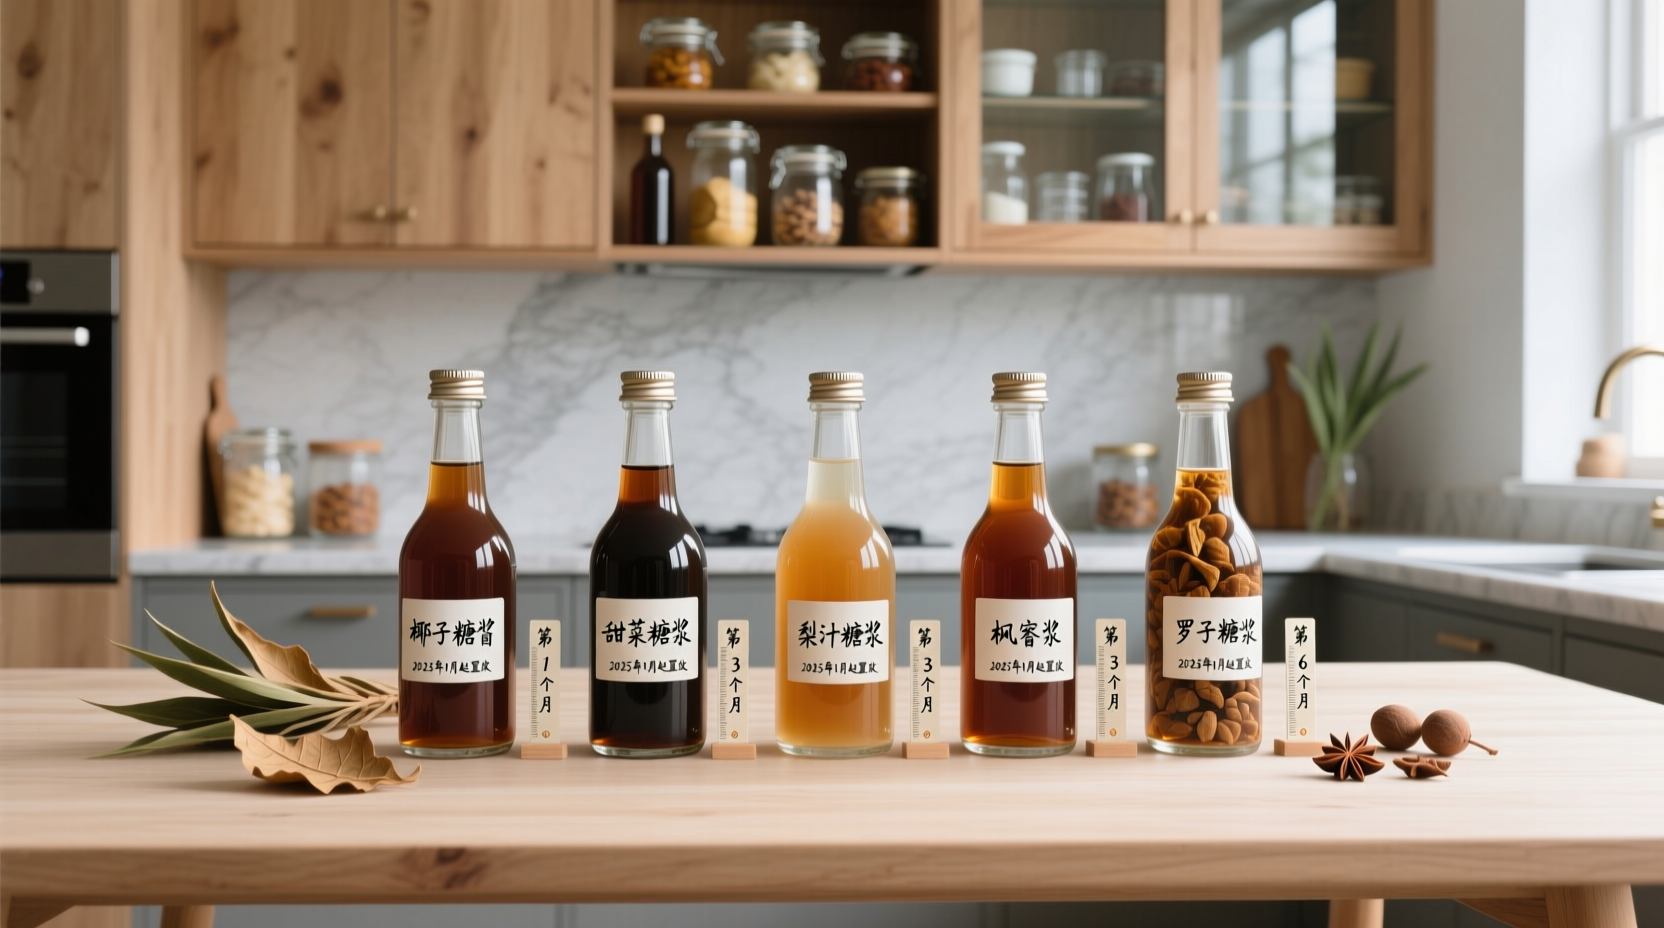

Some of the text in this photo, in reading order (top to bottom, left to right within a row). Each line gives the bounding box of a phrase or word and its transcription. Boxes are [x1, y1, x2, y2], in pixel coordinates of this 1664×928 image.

[537, 626, 554, 713] 第1个月
[601, 618, 691, 648] 甜菜糖浆
[726, 627, 743, 714] 第3个月
[798, 620, 883, 649] 梨汁糖浆
[918, 627, 935, 714] 第3个月
[1104, 625, 1122, 711] 第3个月
[1176, 618, 1257, 645] 罗子糖浆
[1294, 624, 1311, 709] 第6个月
